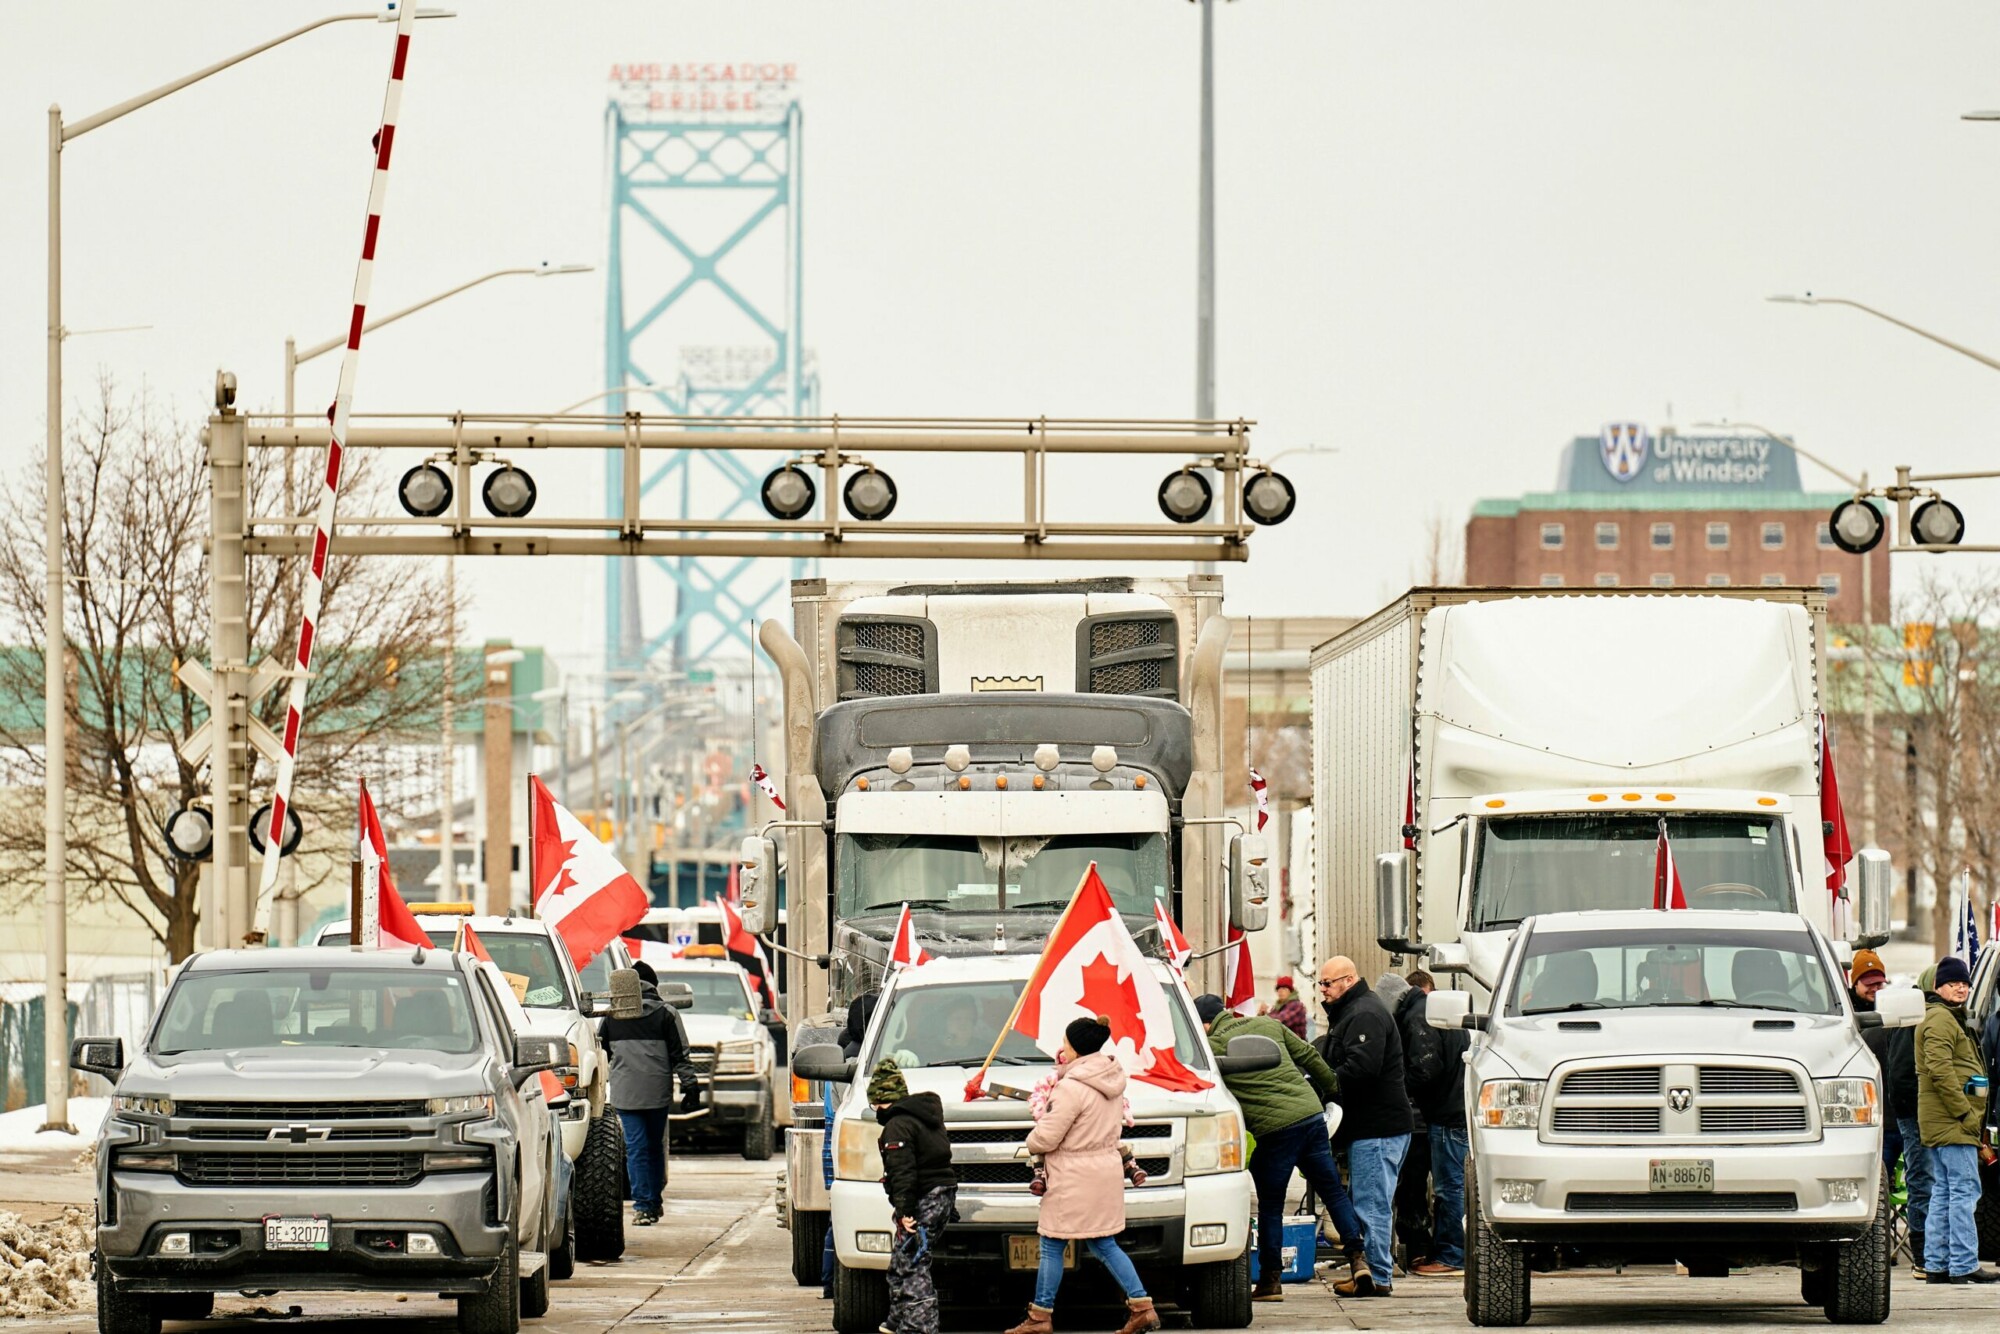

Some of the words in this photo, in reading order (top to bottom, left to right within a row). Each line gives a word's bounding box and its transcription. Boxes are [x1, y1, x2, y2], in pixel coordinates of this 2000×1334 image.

[609, 63, 798, 81] AMBASSADOR
[649, 91, 757, 111] BRIDGE
[1653, 437, 1770, 460] University
[1654, 464, 1671, 482] of
[1672, 460, 1769, 482] Windsor
[1674, 1167, 1711, 1183] 88676
[268, 1226, 282, 1242] BE
[290, 1226, 327, 1242] 32077
